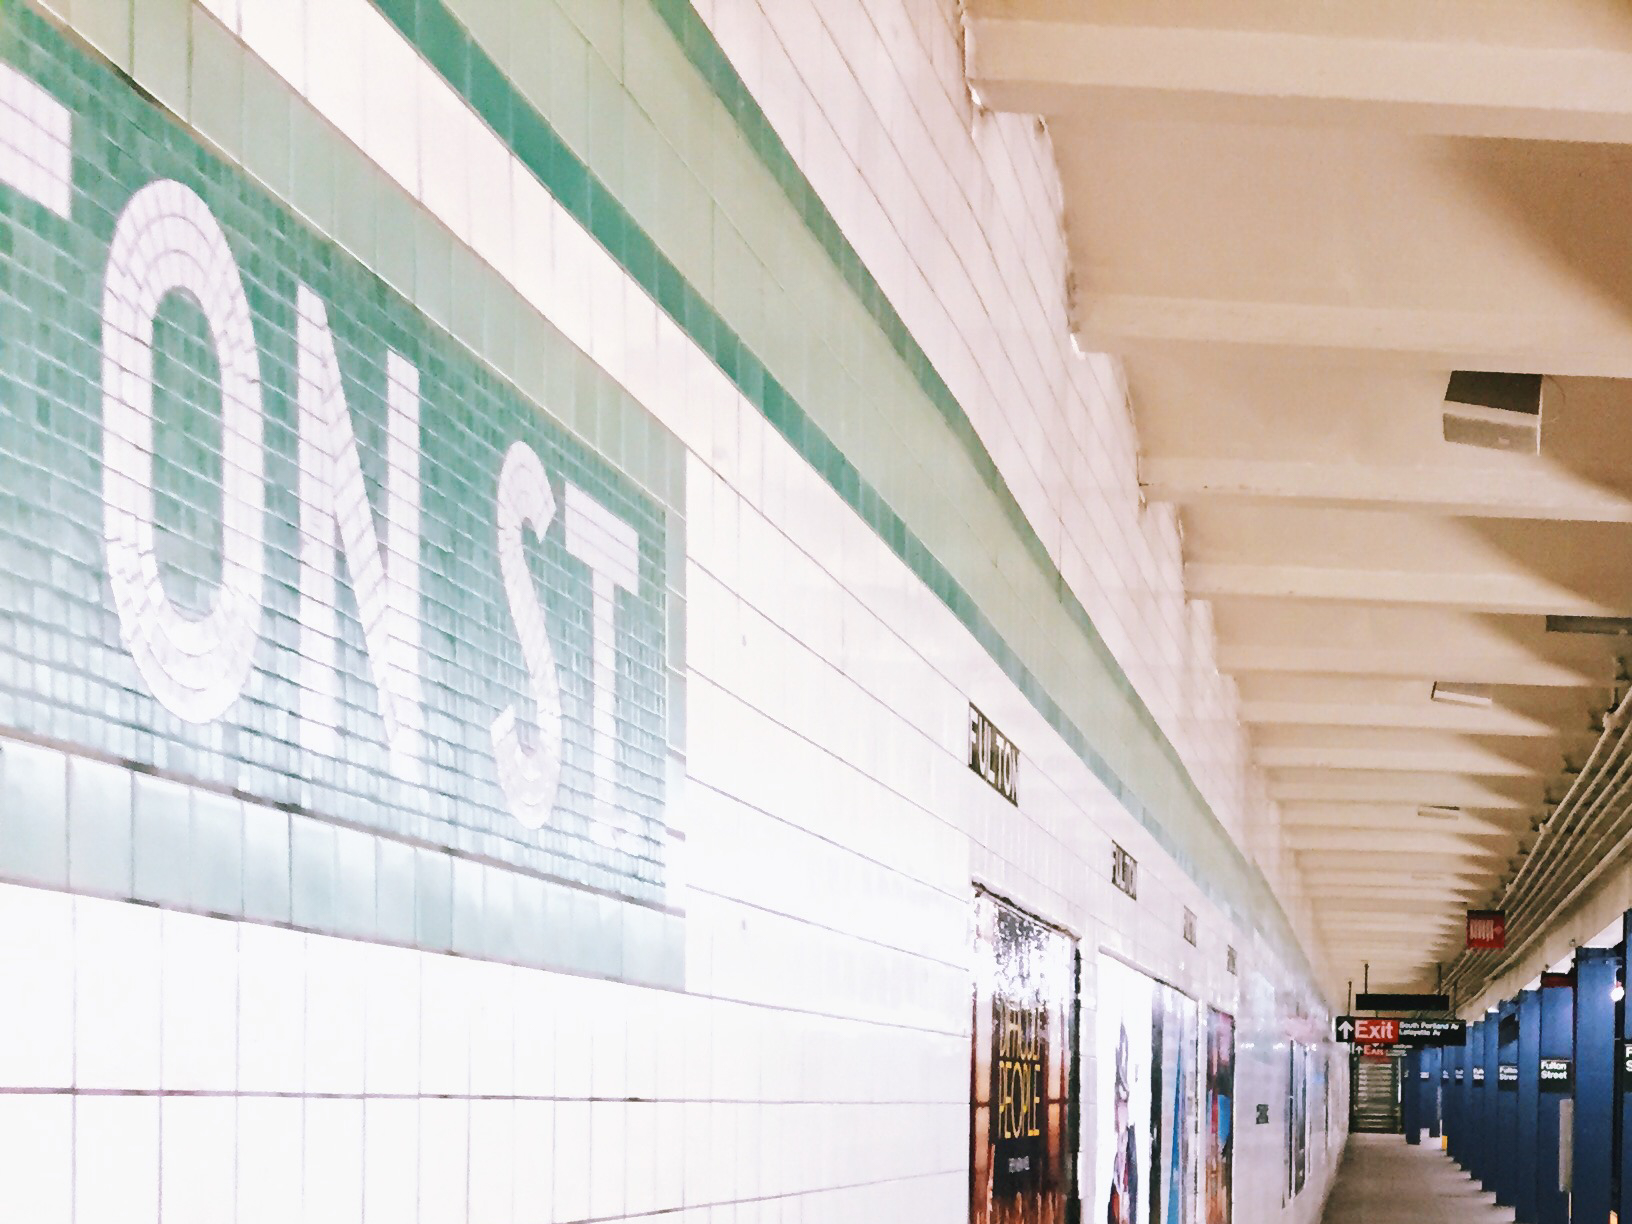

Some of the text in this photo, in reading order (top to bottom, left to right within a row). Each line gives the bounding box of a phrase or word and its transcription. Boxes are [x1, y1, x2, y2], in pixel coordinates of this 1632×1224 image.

[0, 60, 639, 845] ON ST
[967, 704, 1020, 804] FULTON
[1355, 1020, 1393, 1039] Exit
[1541, 1062, 1567, 1071] Fulton
[1541, 1071, 1568, 1080] Street
[999, 1060, 1041, 1139] PEOPLE
